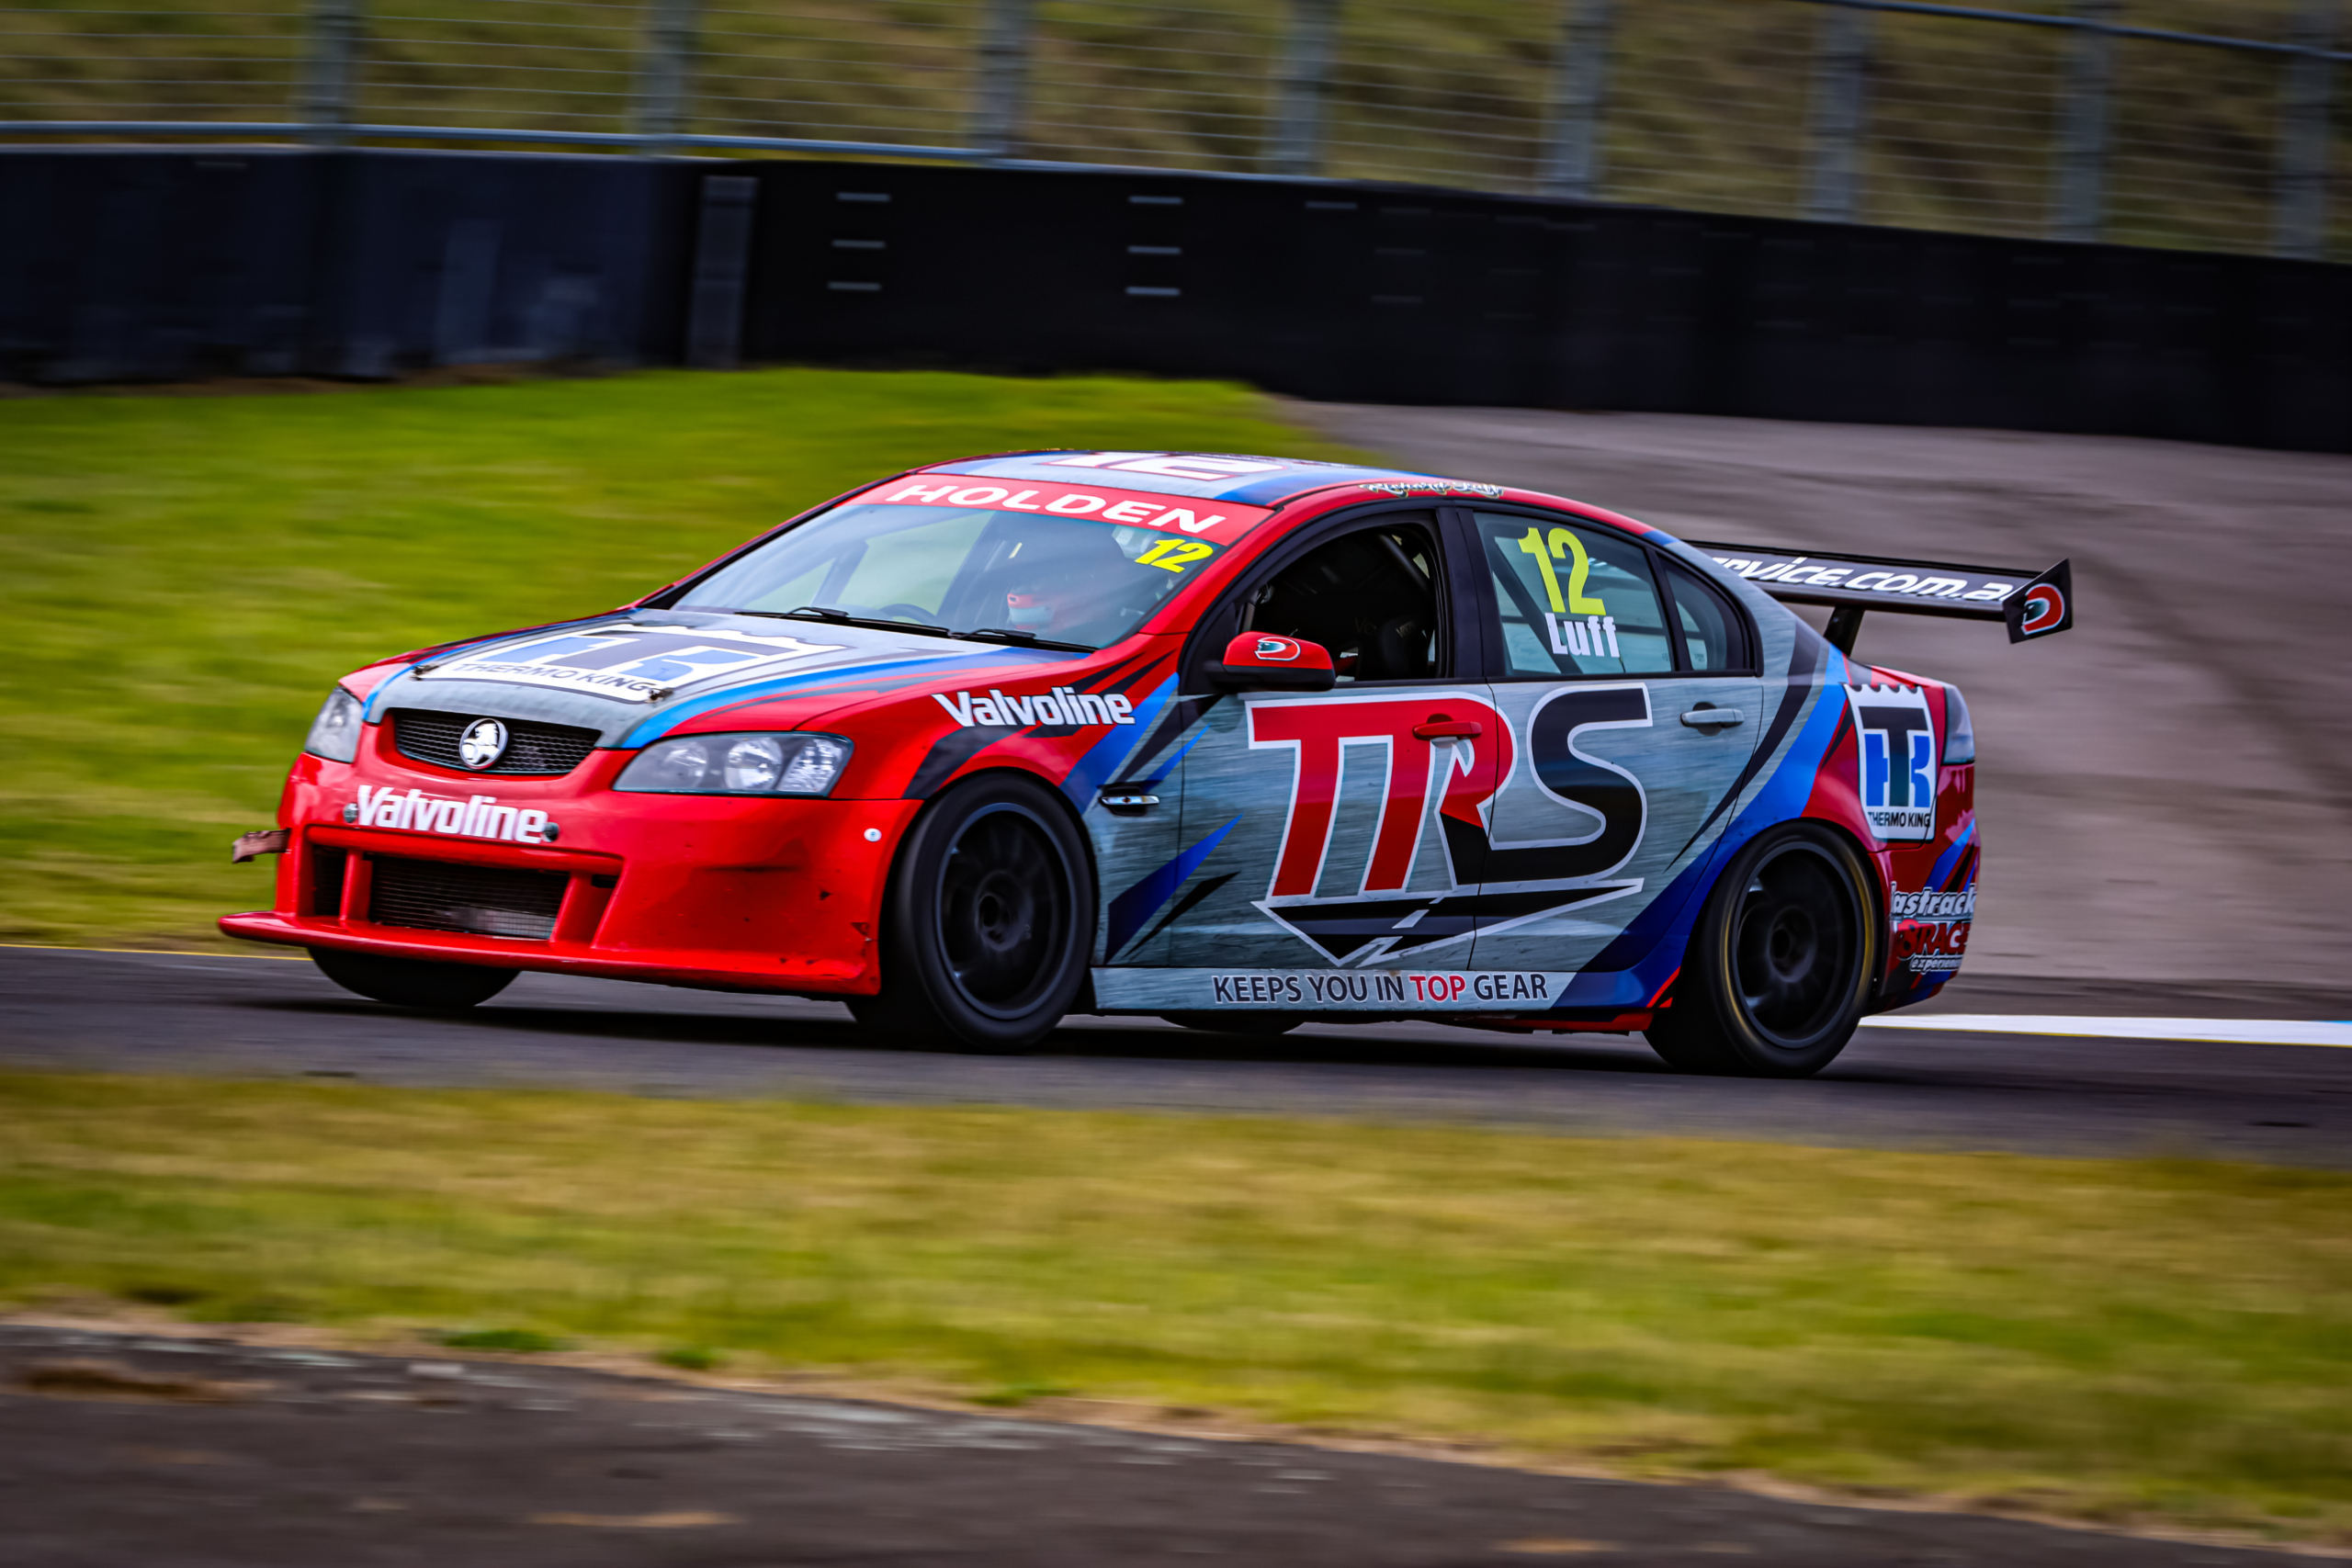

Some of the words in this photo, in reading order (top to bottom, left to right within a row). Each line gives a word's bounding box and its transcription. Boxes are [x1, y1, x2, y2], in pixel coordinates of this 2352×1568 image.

[885, 484, 1227, 534] HOLDEN
[1134, 538, 1214, 573] 12
[1517, 527, 1607, 616] 12
[1712, 557, 2018, 603] rvice.com.a
[1544, 612, 1621, 659] Luff
[453, 662, 572, 680] THERMO
[582, 673, 658, 693] KING
[931, 686, 1136, 728] Valvoline
[357, 785, 548, 844] Valvoline
[1868, 812, 1906, 828] THERMO
[1908, 812, 1930, 828] KING
[1213, 976, 1303, 1003] KEEPS
[1306, 976, 1369, 1003] YOU
[1374, 976, 1407, 1002] IN
[1409, 976, 1466, 1002] TOP
[1473, 974, 1549, 1000] GEAR
